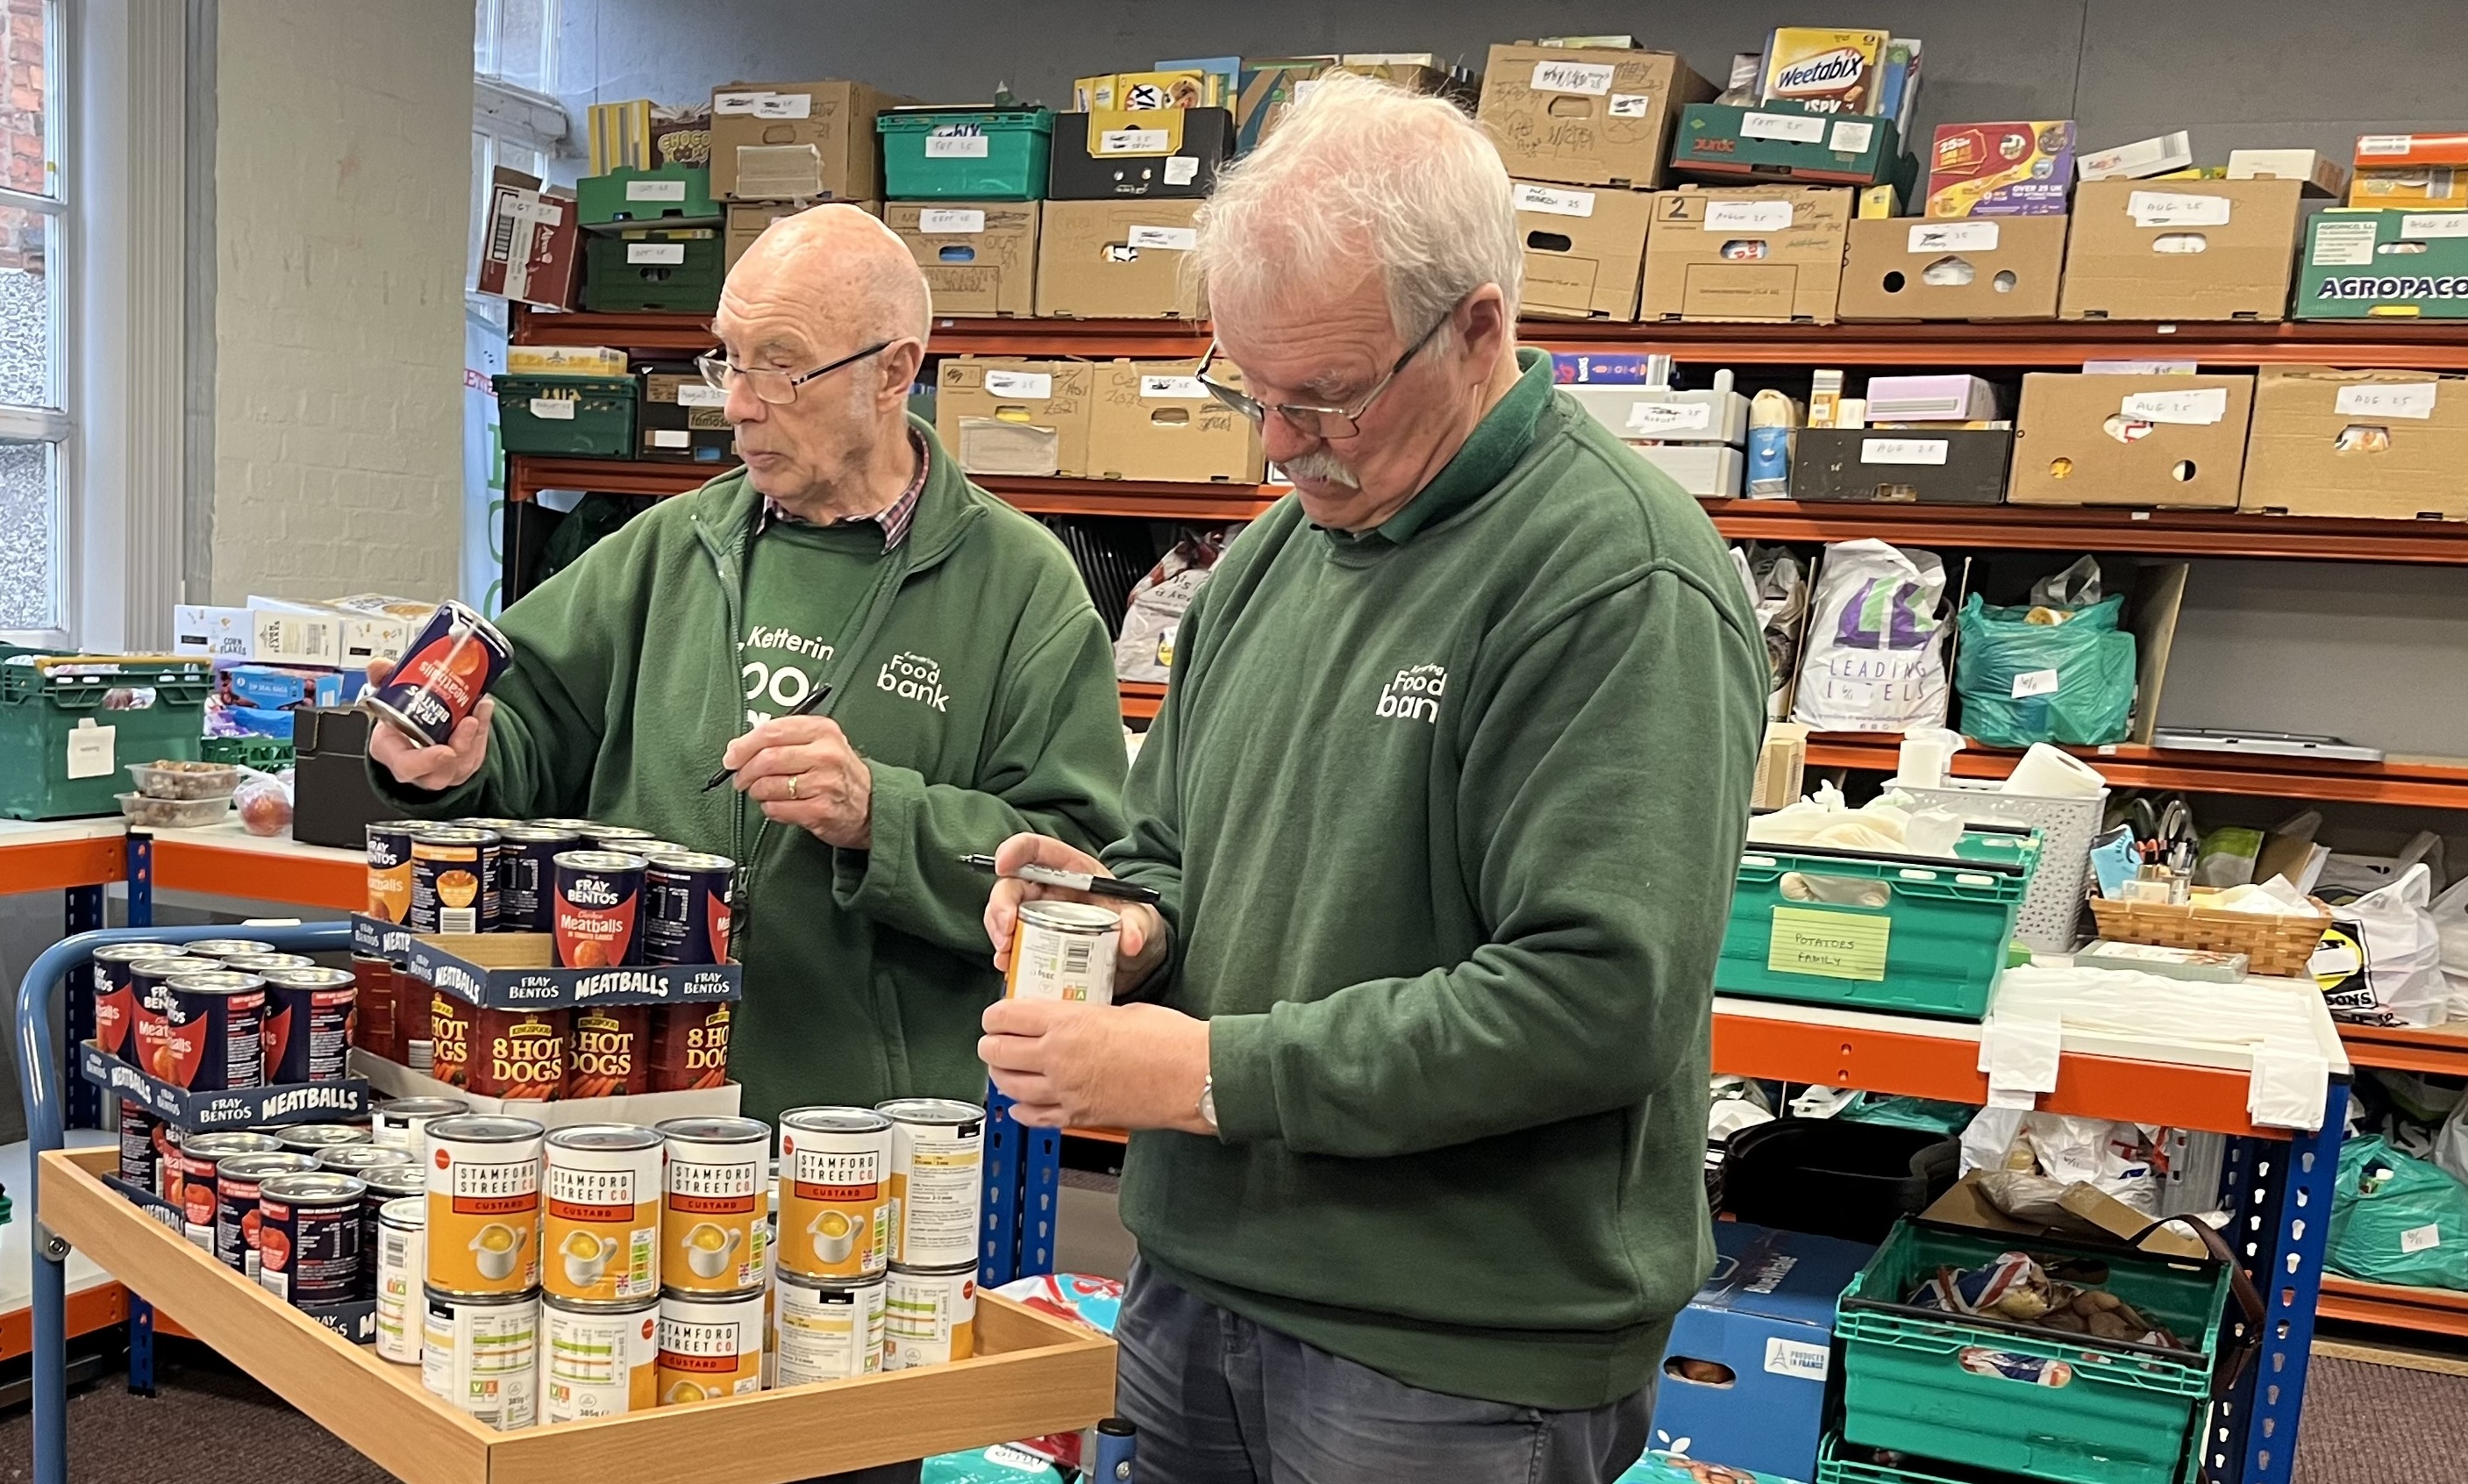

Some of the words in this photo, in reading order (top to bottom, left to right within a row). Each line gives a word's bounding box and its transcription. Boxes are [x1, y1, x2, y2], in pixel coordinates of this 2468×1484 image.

[1779, 55, 1865, 89] Weetabix
[660, 131, 711, 148] CHOCO
[1668, 196, 1689, 219] 2
[2317, 275, 2468, 300] AGROPACO
[220, 646, 246, 655] FLAKES
[746, 625, 834, 661] Ketterin
[890, 654, 942, 685] Food
[1830, 659, 1928, 679] LEADING
[418, 660, 470, 709] Meatballs
[877, 663, 950, 713] bank
[1392, 669, 1448, 697] Food
[1375, 683, 1440, 724] ban
[575, 878, 610, 893] FRAY
[567, 889, 619, 905] BENTOS
[560, 914, 624, 934] Meatballs
[435, 966, 481, 1005] MEATBALLS
[521, 976, 552, 988] FRAY
[695, 972, 723, 983] FRAY
[509, 985, 560, 999] BENTOS
[574, 971, 669, 1002] MEATBALLS
[683, 981, 731, 995] BENTOS
[578, 1031, 633, 1053] HOT
[687, 1028, 703, 1048] 8
[492, 1038, 509, 1059] 8
[510, 1037, 563, 1060] HOT
[492, 1058, 562, 1082] DOGS
[211, 1097, 243, 1110] FRAY
[262, 1087, 359, 1121] MEATBALLS
[200, 1105, 253, 1124] BENTOS
[801, 1154, 874, 1169] STAMFORD
[460, 1164, 535, 1181] STAMFORD
[553, 1170, 627, 1188] STAMFORD
[676, 1166, 751, 1181] STAMFORD
[800, 1167, 853, 1181] STREET
[460, 1181, 516, 1193] STREET
[553, 1184, 603, 1201] STREET
[676, 1179, 729, 1194] STREET
[812, 1188, 861, 1197] CUSTARD
[474, 1199, 524, 1210] CUSTARD
[563, 1207, 612, 1217] CUSTARD
[688, 1201, 738, 1210] CUSTARD
[660, 1320, 733, 1340] STAMFORD
[660, 1335, 709, 1352] STREET
[669, 1356, 717, 1368] CUSTARD
